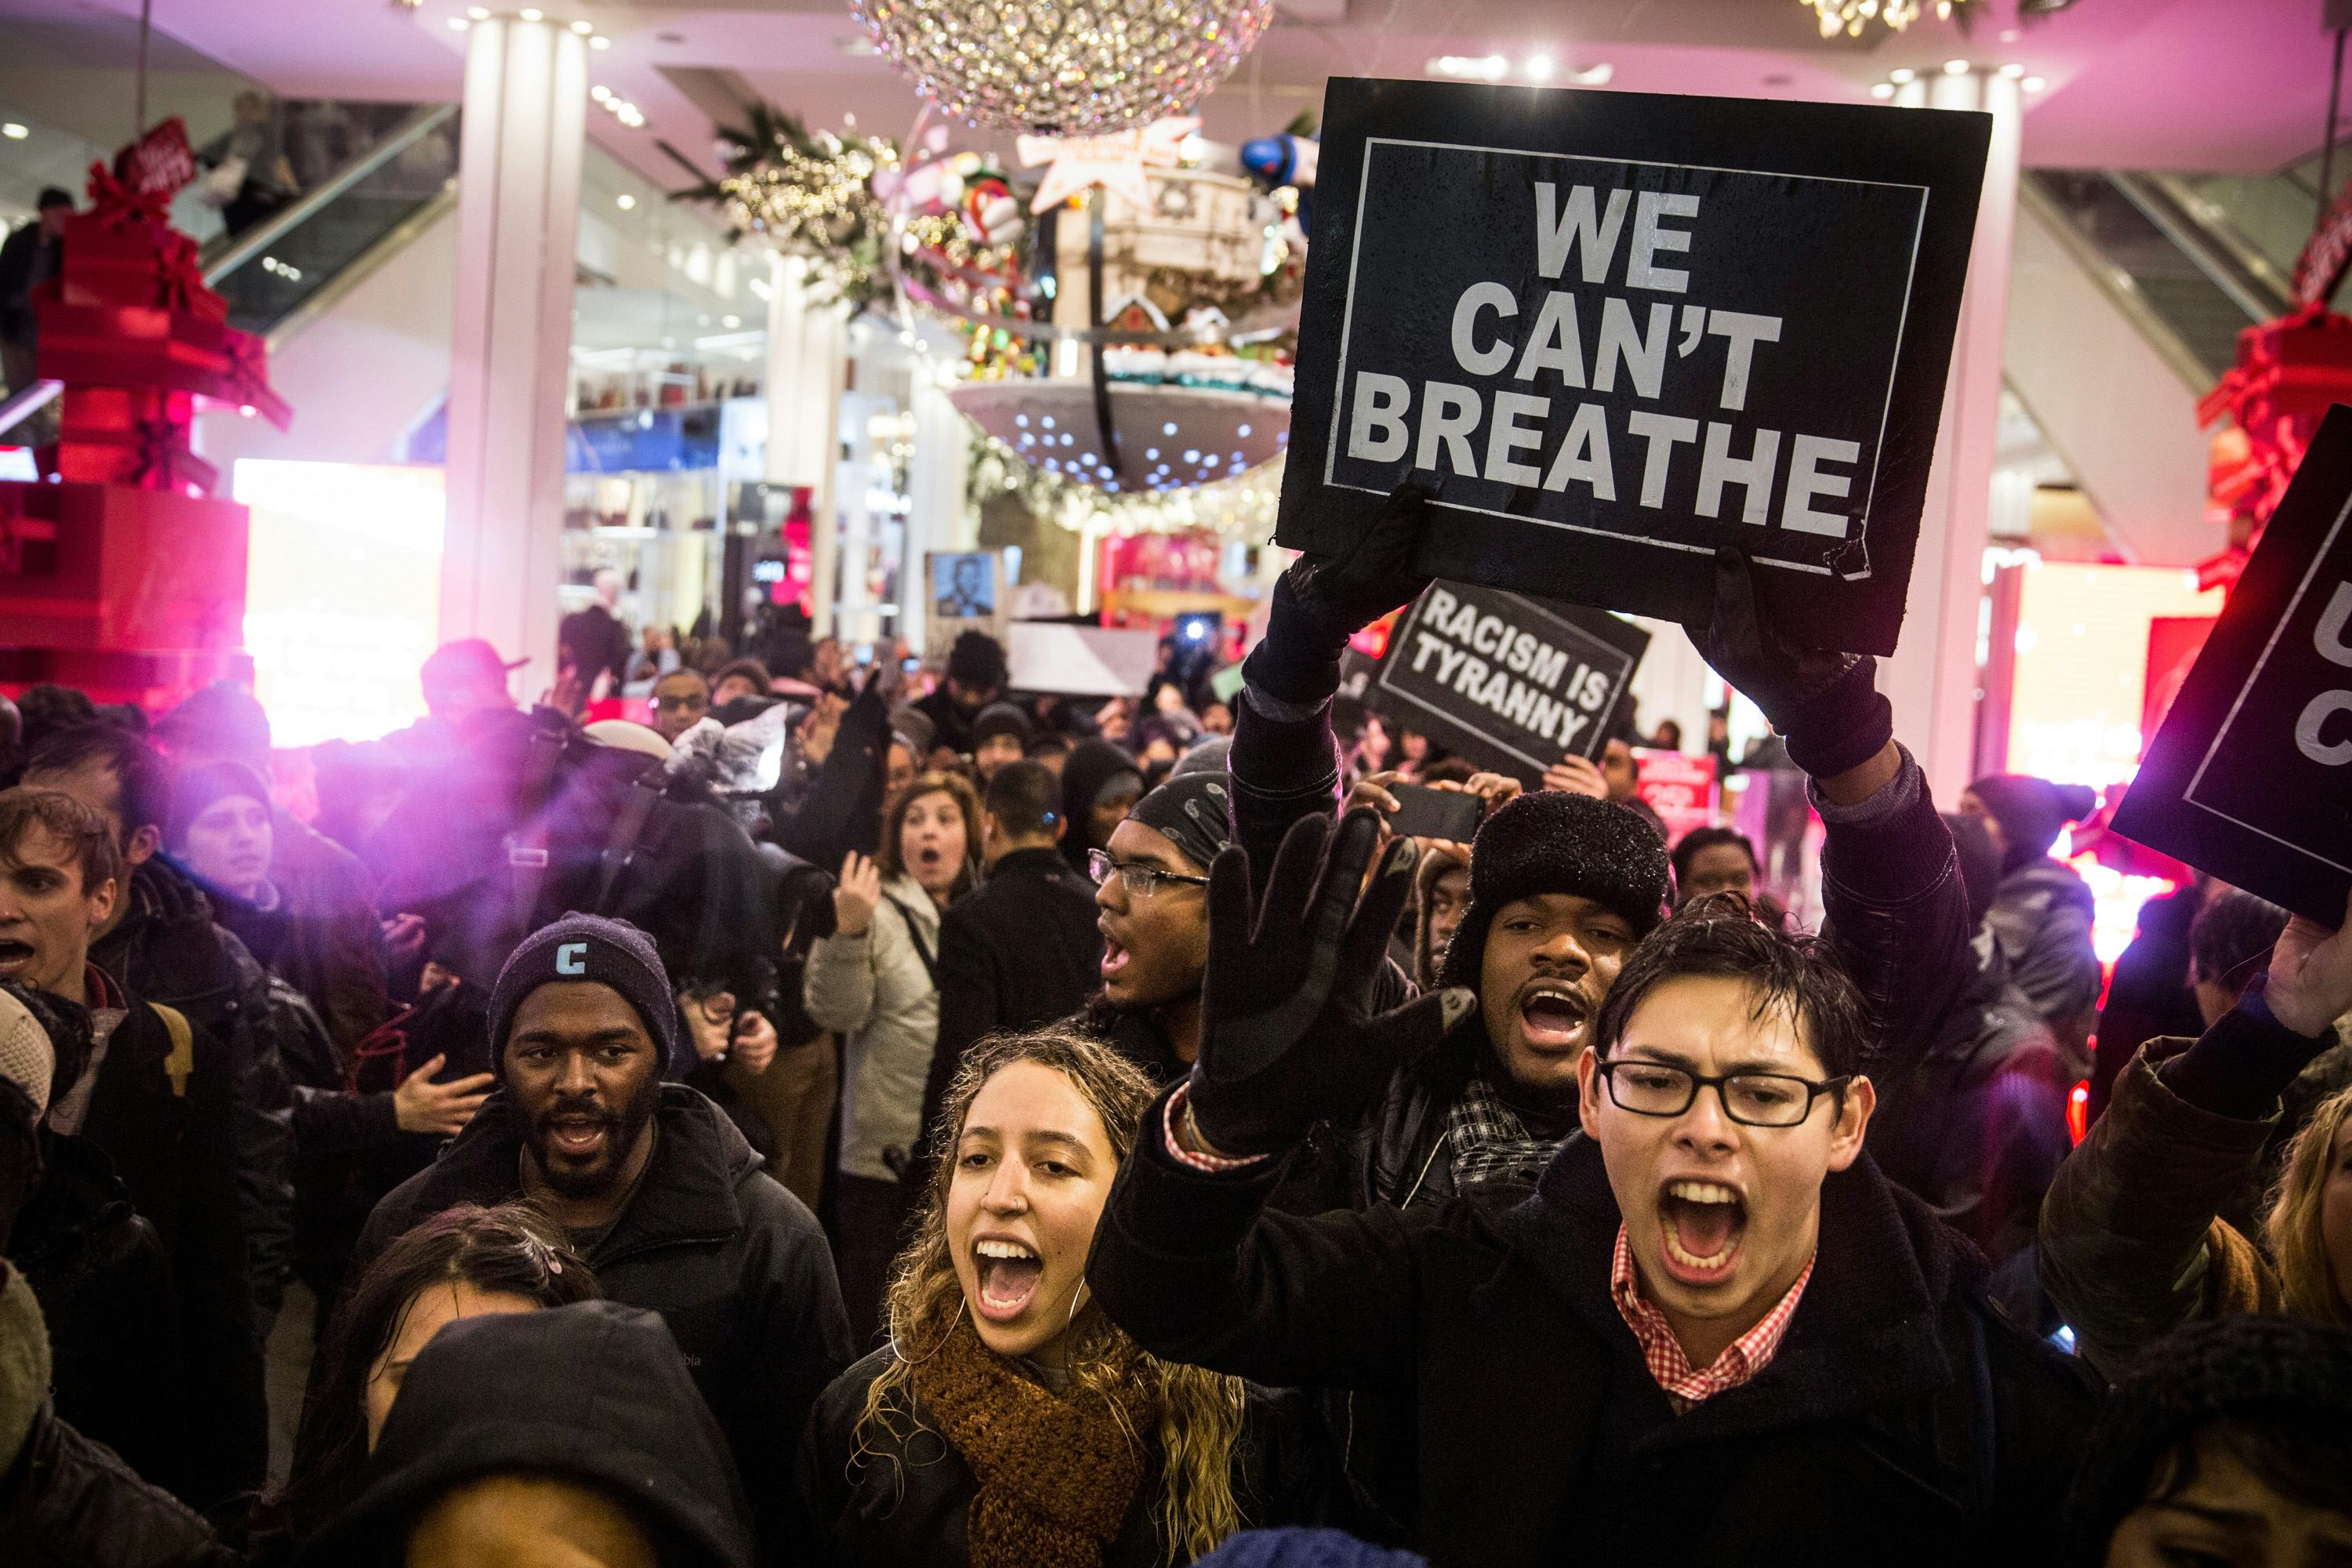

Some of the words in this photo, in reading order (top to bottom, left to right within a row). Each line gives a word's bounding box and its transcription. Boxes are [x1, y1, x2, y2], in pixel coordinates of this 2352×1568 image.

[1534, 181, 1700, 293] WE
[1451, 281, 1783, 412] CAN'T
[1347, 370, 1860, 539] BREATHE
[1412, 630, 1590, 749] TYRANNY
[1421, 588, 1570, 690] RACISM
[1565, 662, 1610, 712] IS
[556, 942, 587, 975] C
